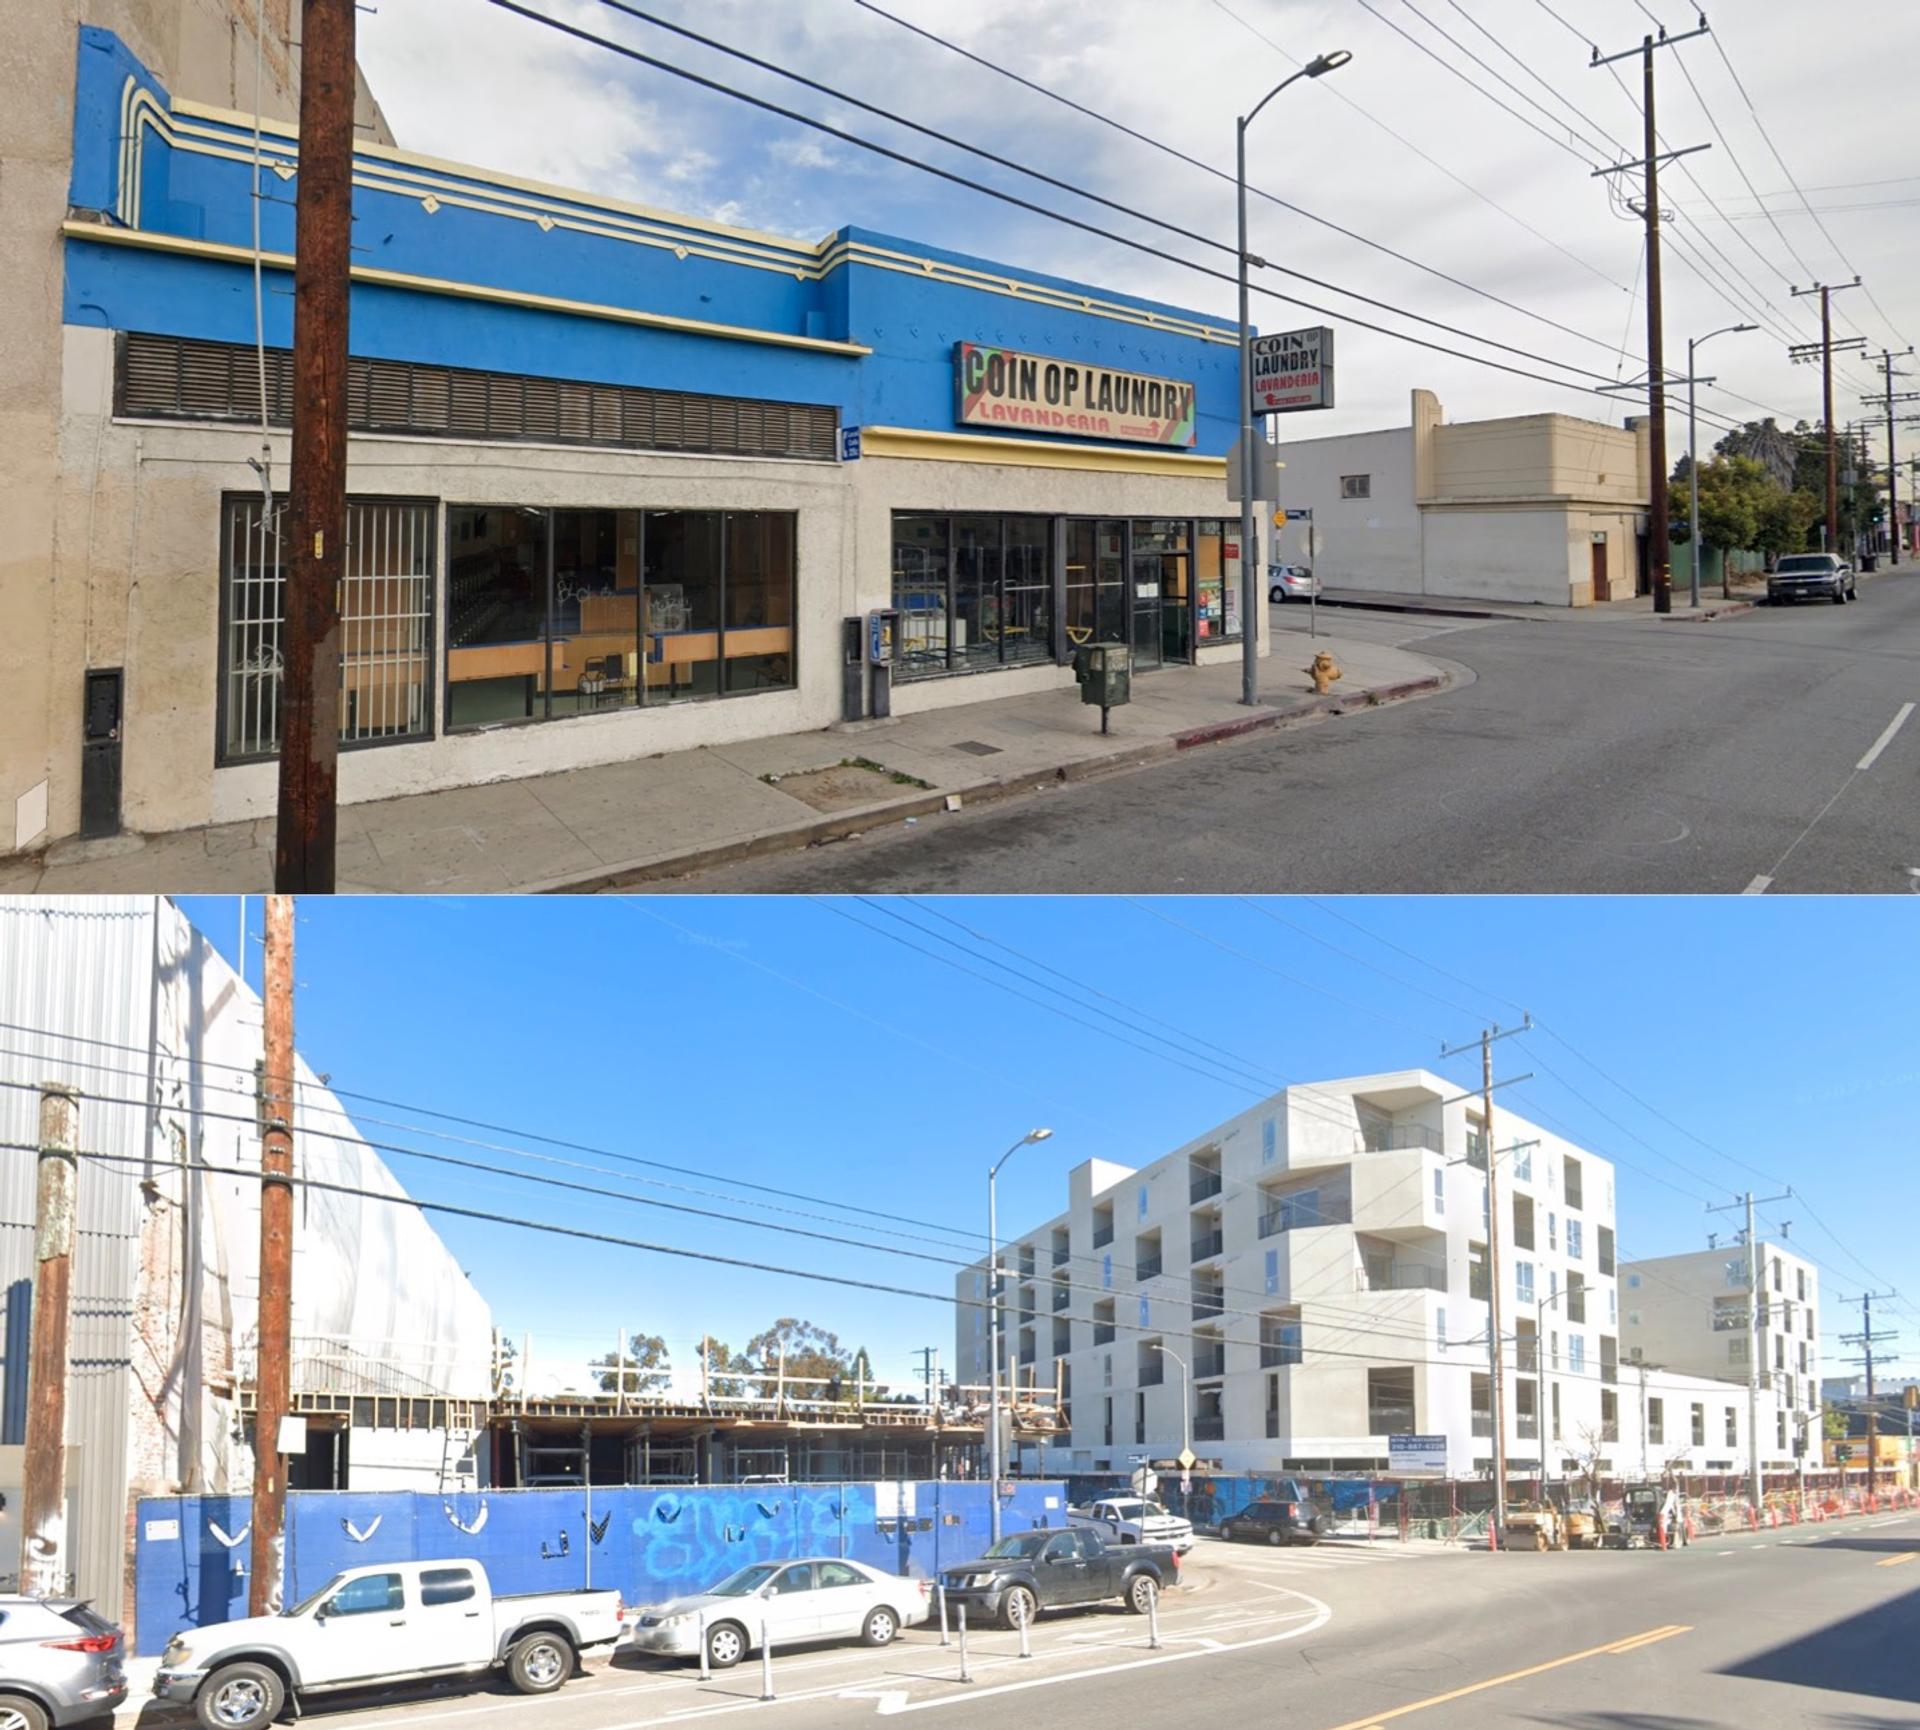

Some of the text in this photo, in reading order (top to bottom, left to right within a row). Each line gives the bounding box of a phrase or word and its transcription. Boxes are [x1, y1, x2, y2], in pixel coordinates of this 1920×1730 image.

[1255, 335, 1304, 356] COIN
[1255, 348, 1319, 377] LAUNDRY
[965, 350, 1193, 423] COIN OP LAUNDRY
[1255, 371, 1320, 394] LAVANDERIA
[979, 401, 1110, 433] LAVANDERIA
